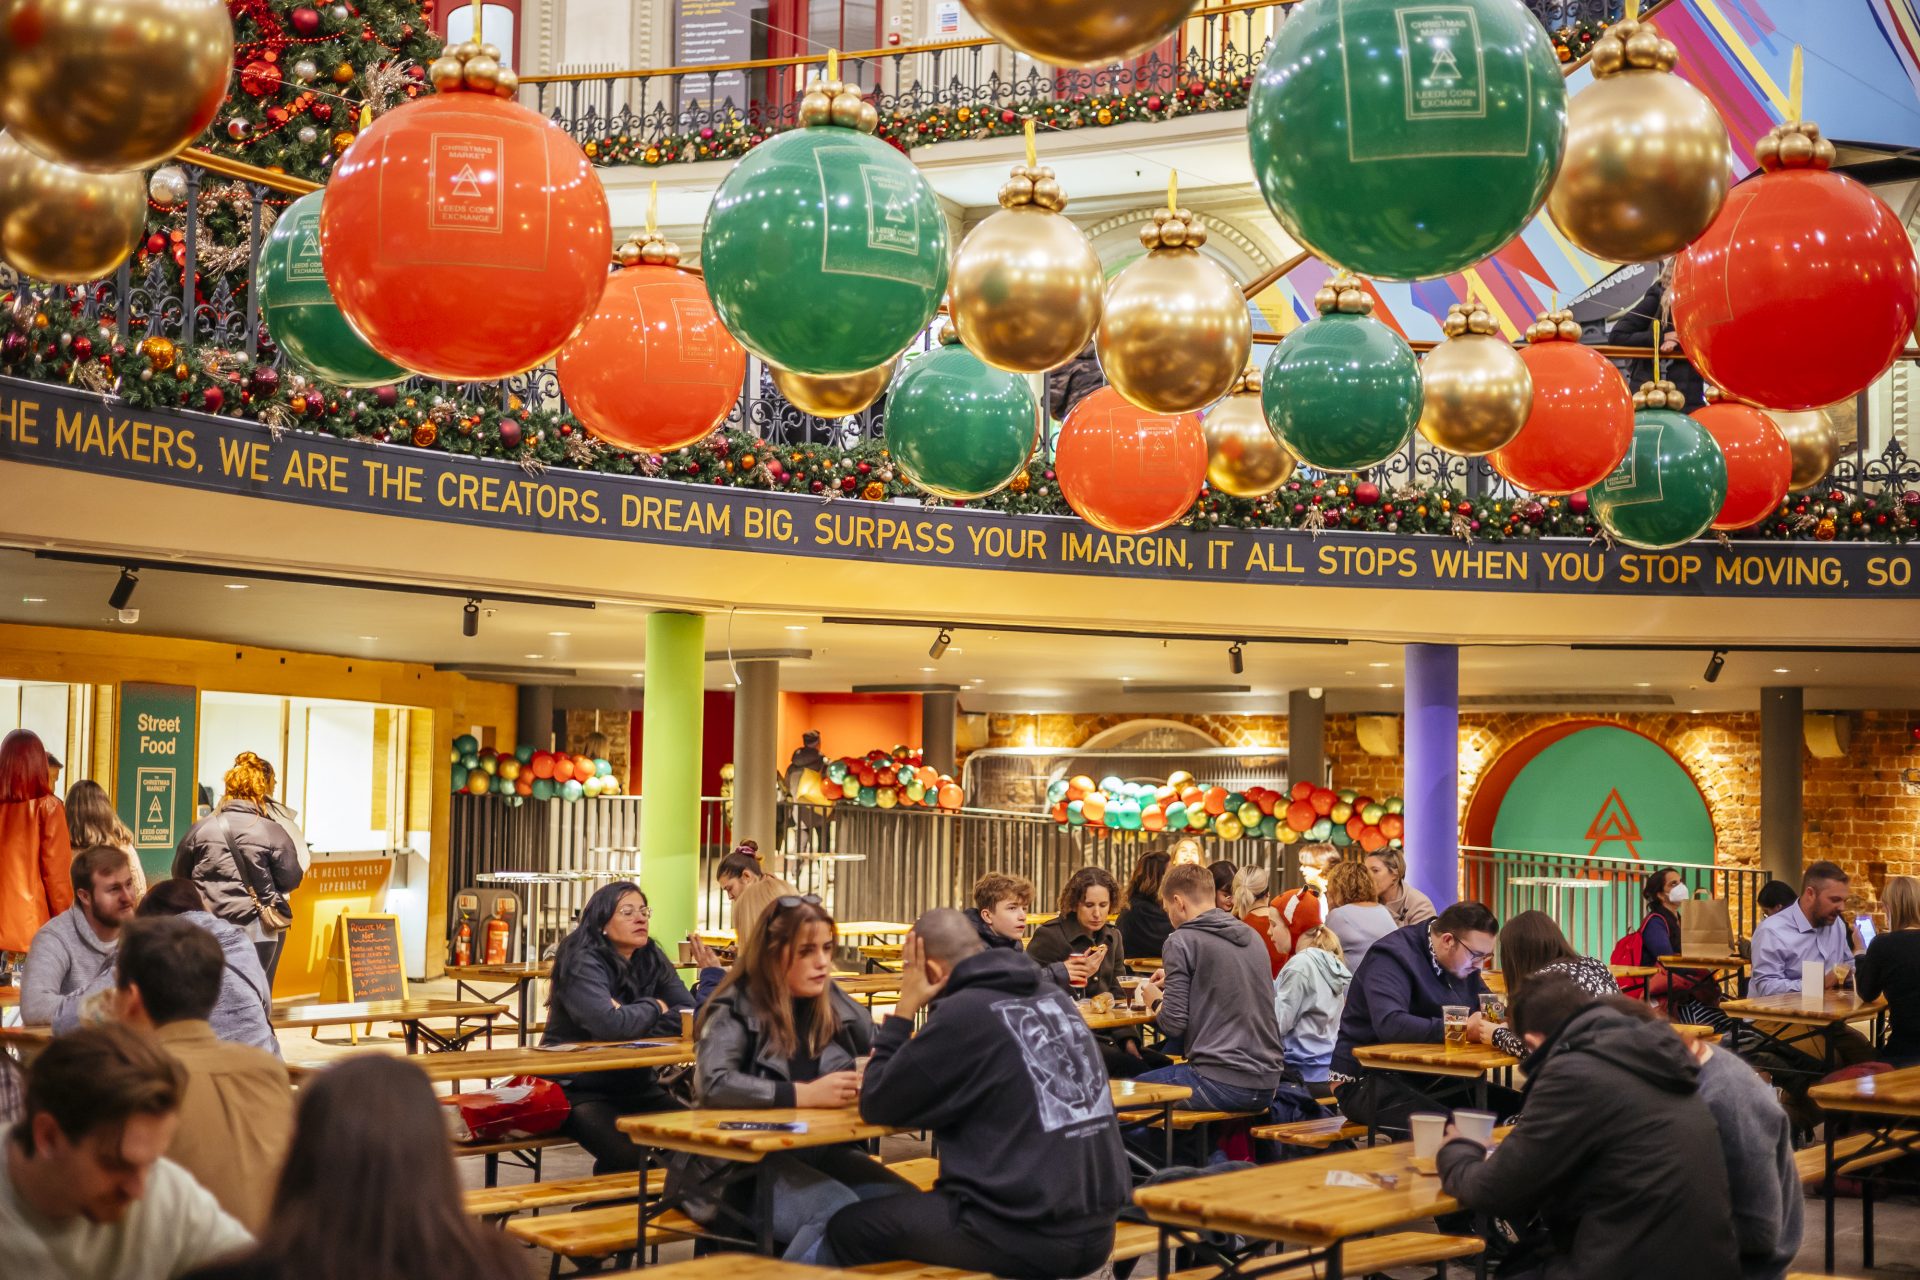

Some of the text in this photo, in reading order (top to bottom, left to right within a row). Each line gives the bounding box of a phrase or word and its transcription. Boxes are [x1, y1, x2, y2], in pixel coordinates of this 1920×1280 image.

[1410, 20, 1467, 29] CHRISTMAS
[1420, 28, 1460, 36] MARKET
[1416, 89, 1477, 99] LEEDS CORN
[1421, 98, 1472, 108] EXCHANGE
[441, 144, 493, 154] CHRISTMAS
[448, 152, 486, 160] MARKET
[438, 204, 467, 213] LEEDS
[442, 213, 490, 222] EXCHANGE
[0, 399, 1912, 588] HE MAKERS, WE ARE THE CREATORS. DREAM BIG, SURPASS YOUR IMARGIN, IT ALL STOPS WHEN YOU STOP MOVING, SO
[137, 713, 181, 733] Street
[140, 735, 176, 755] Food
[321, 866, 350, 878] MELTED
[353, 864, 383, 876] CHEESE
[319, 880, 367, 893] EXPERIENCE
